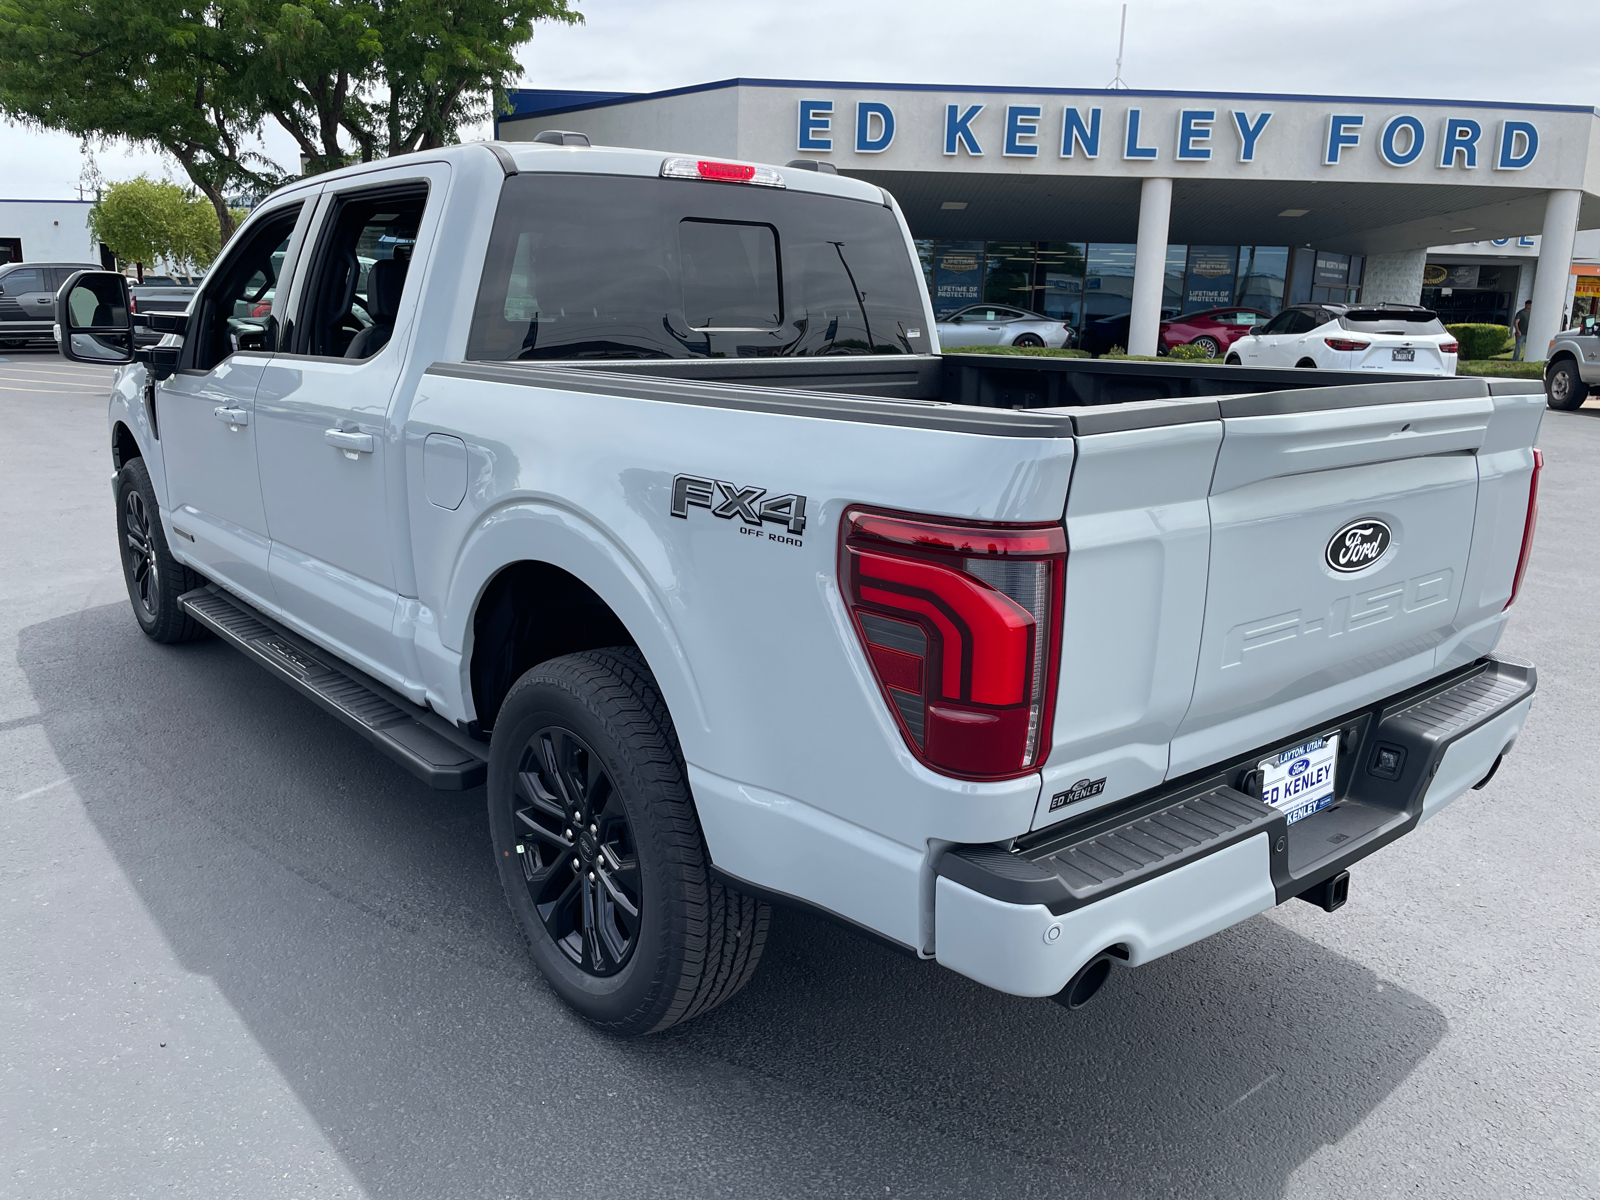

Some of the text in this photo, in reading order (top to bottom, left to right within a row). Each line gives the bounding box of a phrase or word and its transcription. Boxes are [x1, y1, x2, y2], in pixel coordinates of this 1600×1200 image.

[797, 99, 1540, 171] ED KENLEY FORD
[670, 472, 807, 536] FX4
[739, 526, 803, 547] OFF ROAD
[1338, 527, 1383, 565] Ford
[1220, 567, 1455, 670] F-150
[1306, 738, 1324, 754] UTAH
[1262, 786, 1280, 805] ED
[1283, 763, 1332, 799] KENLEY
[1291, 761, 1307, 776] Ford
[1051, 781, 1106, 808] ED KENLEY
[1286, 800, 1319, 825] KENLEY
